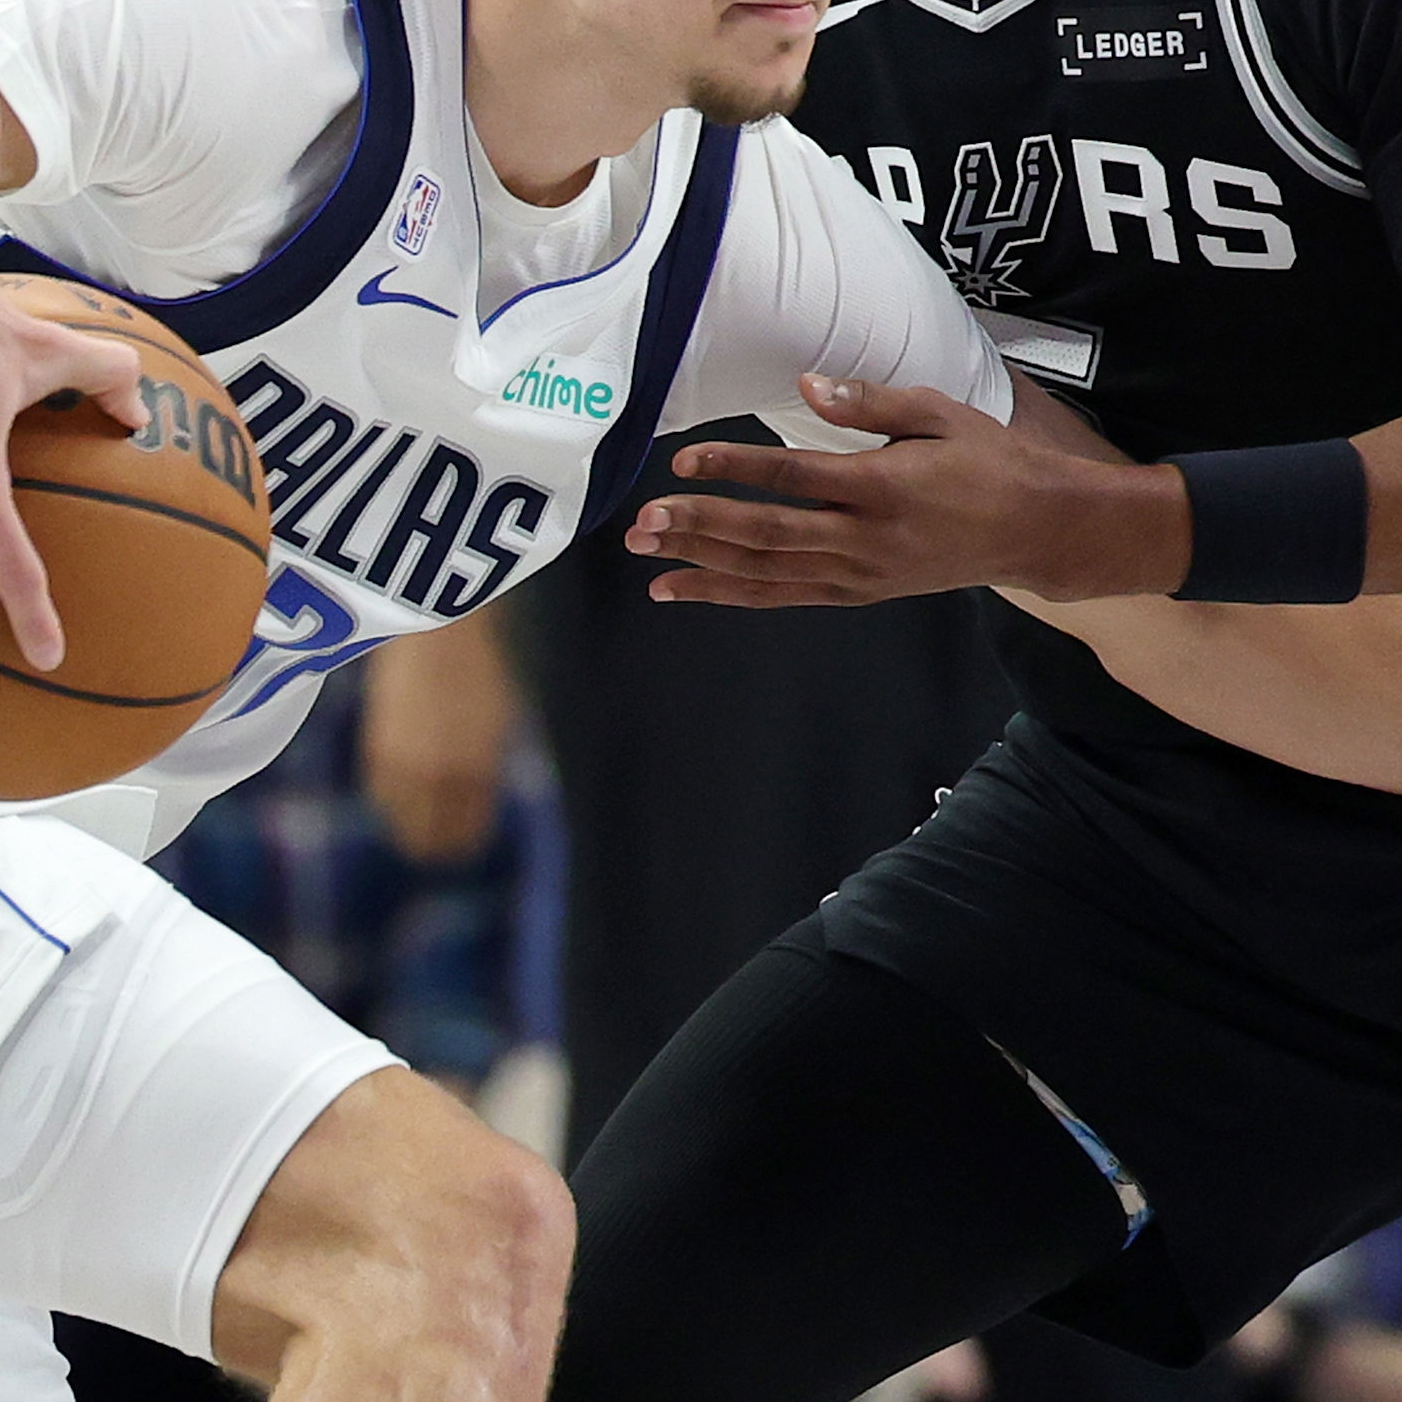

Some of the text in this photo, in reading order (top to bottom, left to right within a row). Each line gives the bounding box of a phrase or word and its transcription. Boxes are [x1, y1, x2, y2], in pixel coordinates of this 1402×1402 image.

[1076, 31, 1184, 59] LEDGER
[830, 135, 1296, 305] PURS
[502, 357, 613, 419] chime
